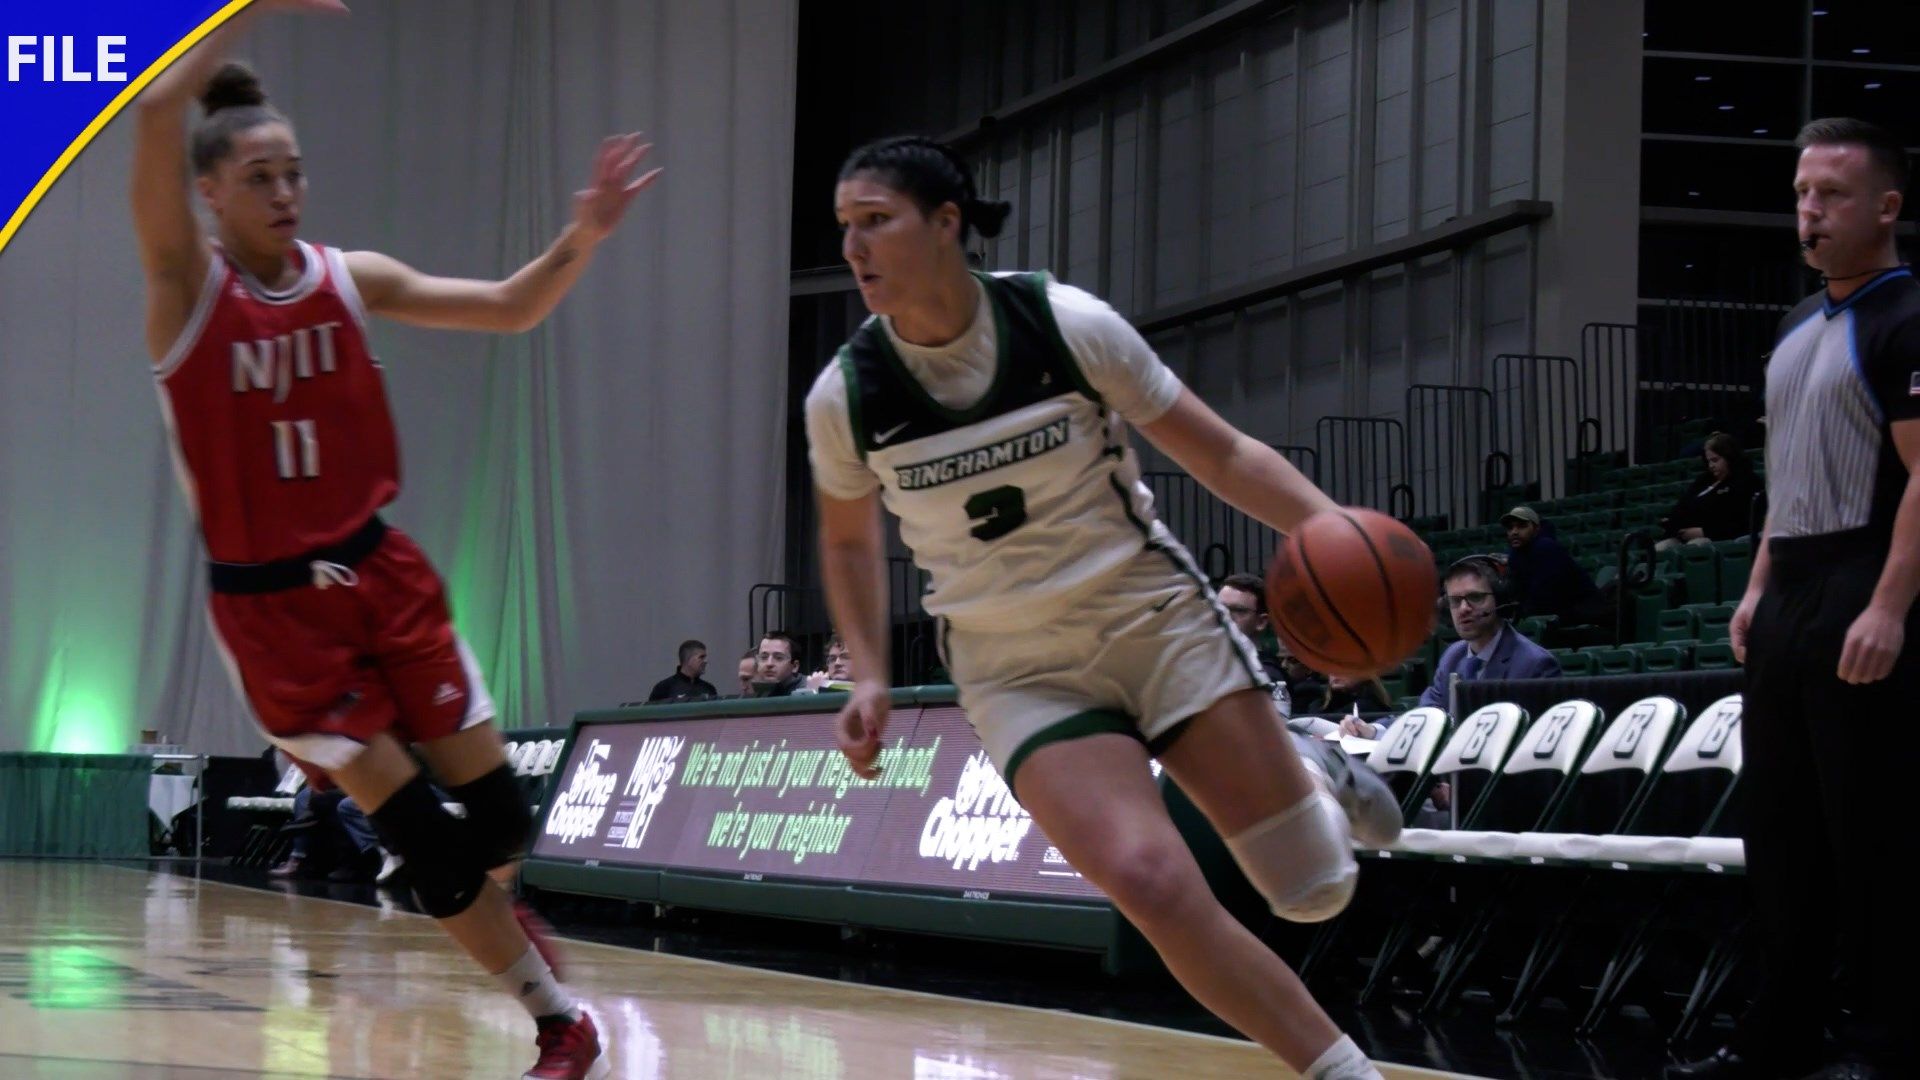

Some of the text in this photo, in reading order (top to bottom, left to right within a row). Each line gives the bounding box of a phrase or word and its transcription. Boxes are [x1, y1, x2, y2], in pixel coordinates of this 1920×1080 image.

[231, 321, 343, 404] NJIT
[270, 419, 321, 479] 11
[894, 416, 1071, 490] BINGHAMTON
[681, 742, 722, 787] We're
[715, 746, 747, 786] not
[734, 739, 775, 797] just
[766, 740, 790, 787] in
[777, 750, 825, 798] your
[546, 791, 606, 844] Chopper
[707, 801, 852, 864] we're your neighbor
[919, 797, 1032, 871] Chopper
